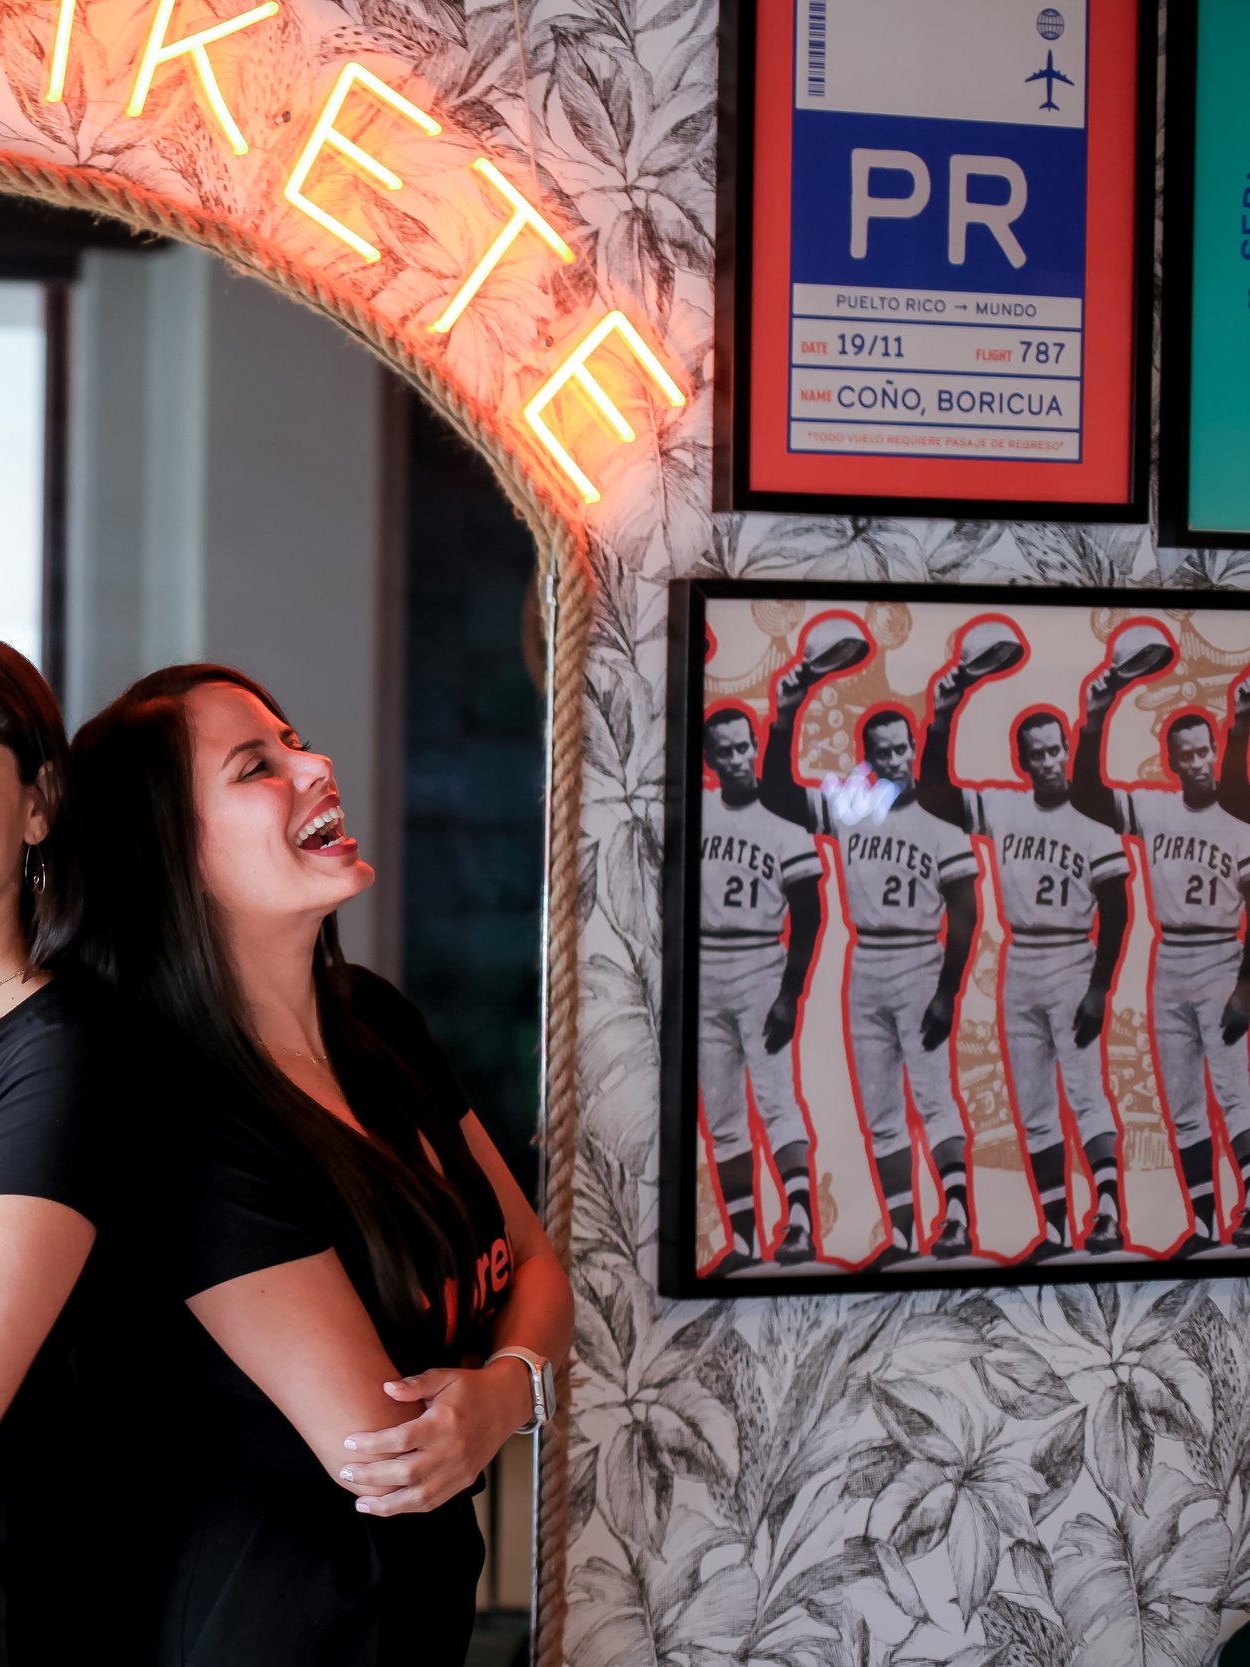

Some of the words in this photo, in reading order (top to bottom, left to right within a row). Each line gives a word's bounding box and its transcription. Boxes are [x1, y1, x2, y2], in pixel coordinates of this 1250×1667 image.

[849, 147, 1029, 269] PR
[836, 294, 900, 311] PUELTO
[905, 298, 947, 313] RICO
[975, 301, 1037, 318] MUNDO
[801, 340, 828, 355] DATE
[837, 333, 904, 358] 19/11
[975, 348, 1012, 362] FLIGHT
[1019, 340, 1066, 364] 787
[800, 389, 832, 403] NAME
[837, 379, 925, 416] COÑO,
[937, 389, 1062, 417] BORICUA
[945, 437, 988, 450] PASAJE
[991, 439, 1006, 450] DE
[847, 833, 932, 880] PIRATES
[1002, 833, 1084, 879] PIRATES
[1153, 833, 1232, 879] PIRATES
[723, 875, 760, 908] 21
[882, 875, 916, 908] 21
[1035, 874, 1070, 906] 21
[1185, 874, 1218, 906] 21
